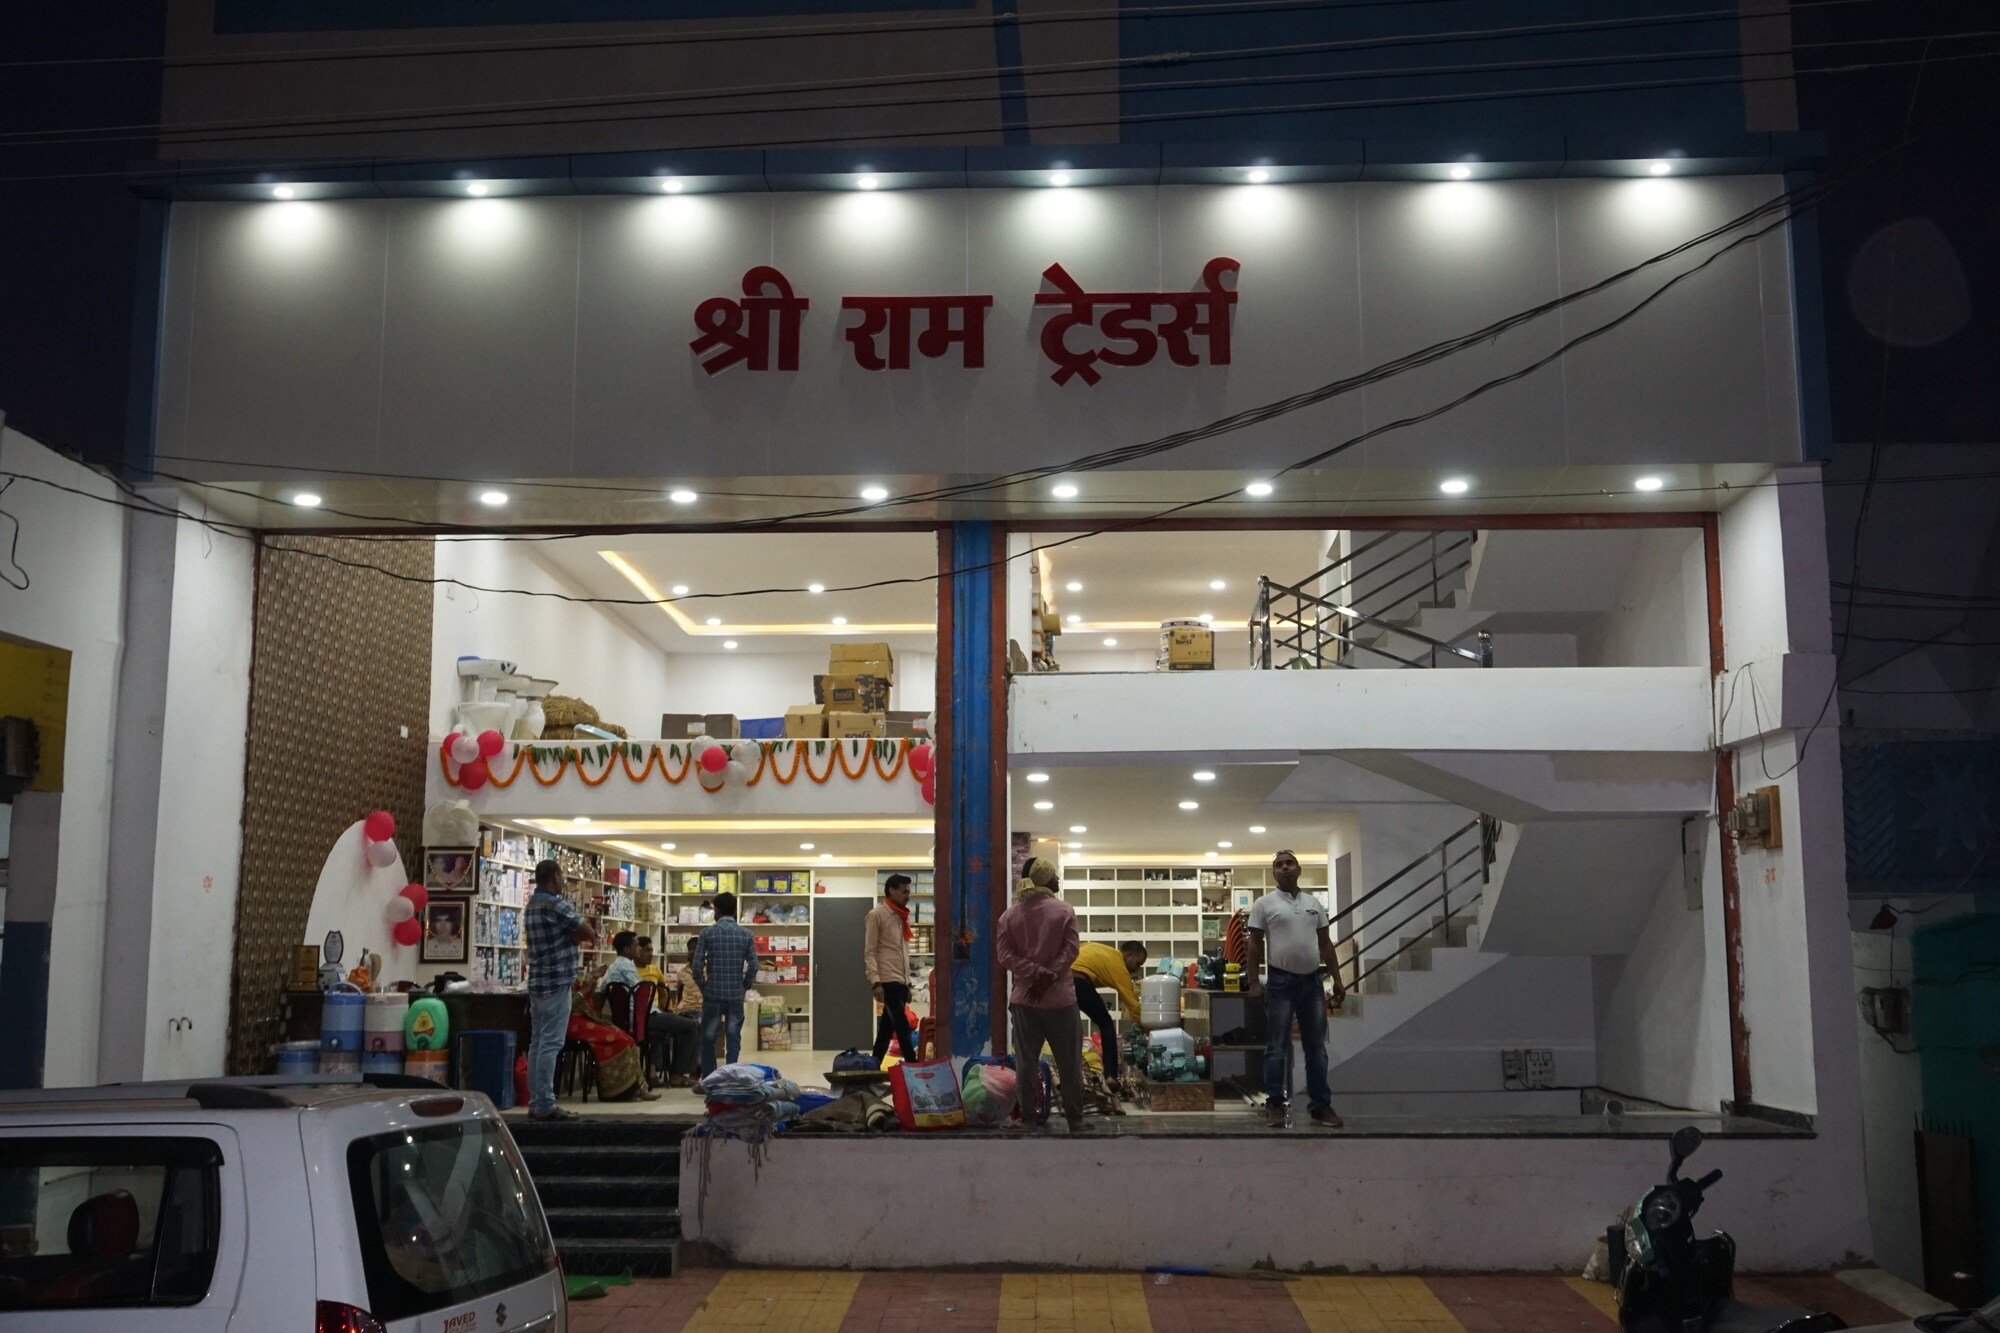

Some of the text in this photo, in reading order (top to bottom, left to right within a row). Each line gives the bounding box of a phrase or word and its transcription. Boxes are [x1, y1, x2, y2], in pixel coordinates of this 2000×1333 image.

[689, 257, 1240, 387] श्री राम ट्रेडर्स
[443, 1311, 476, 1333] JAVED
